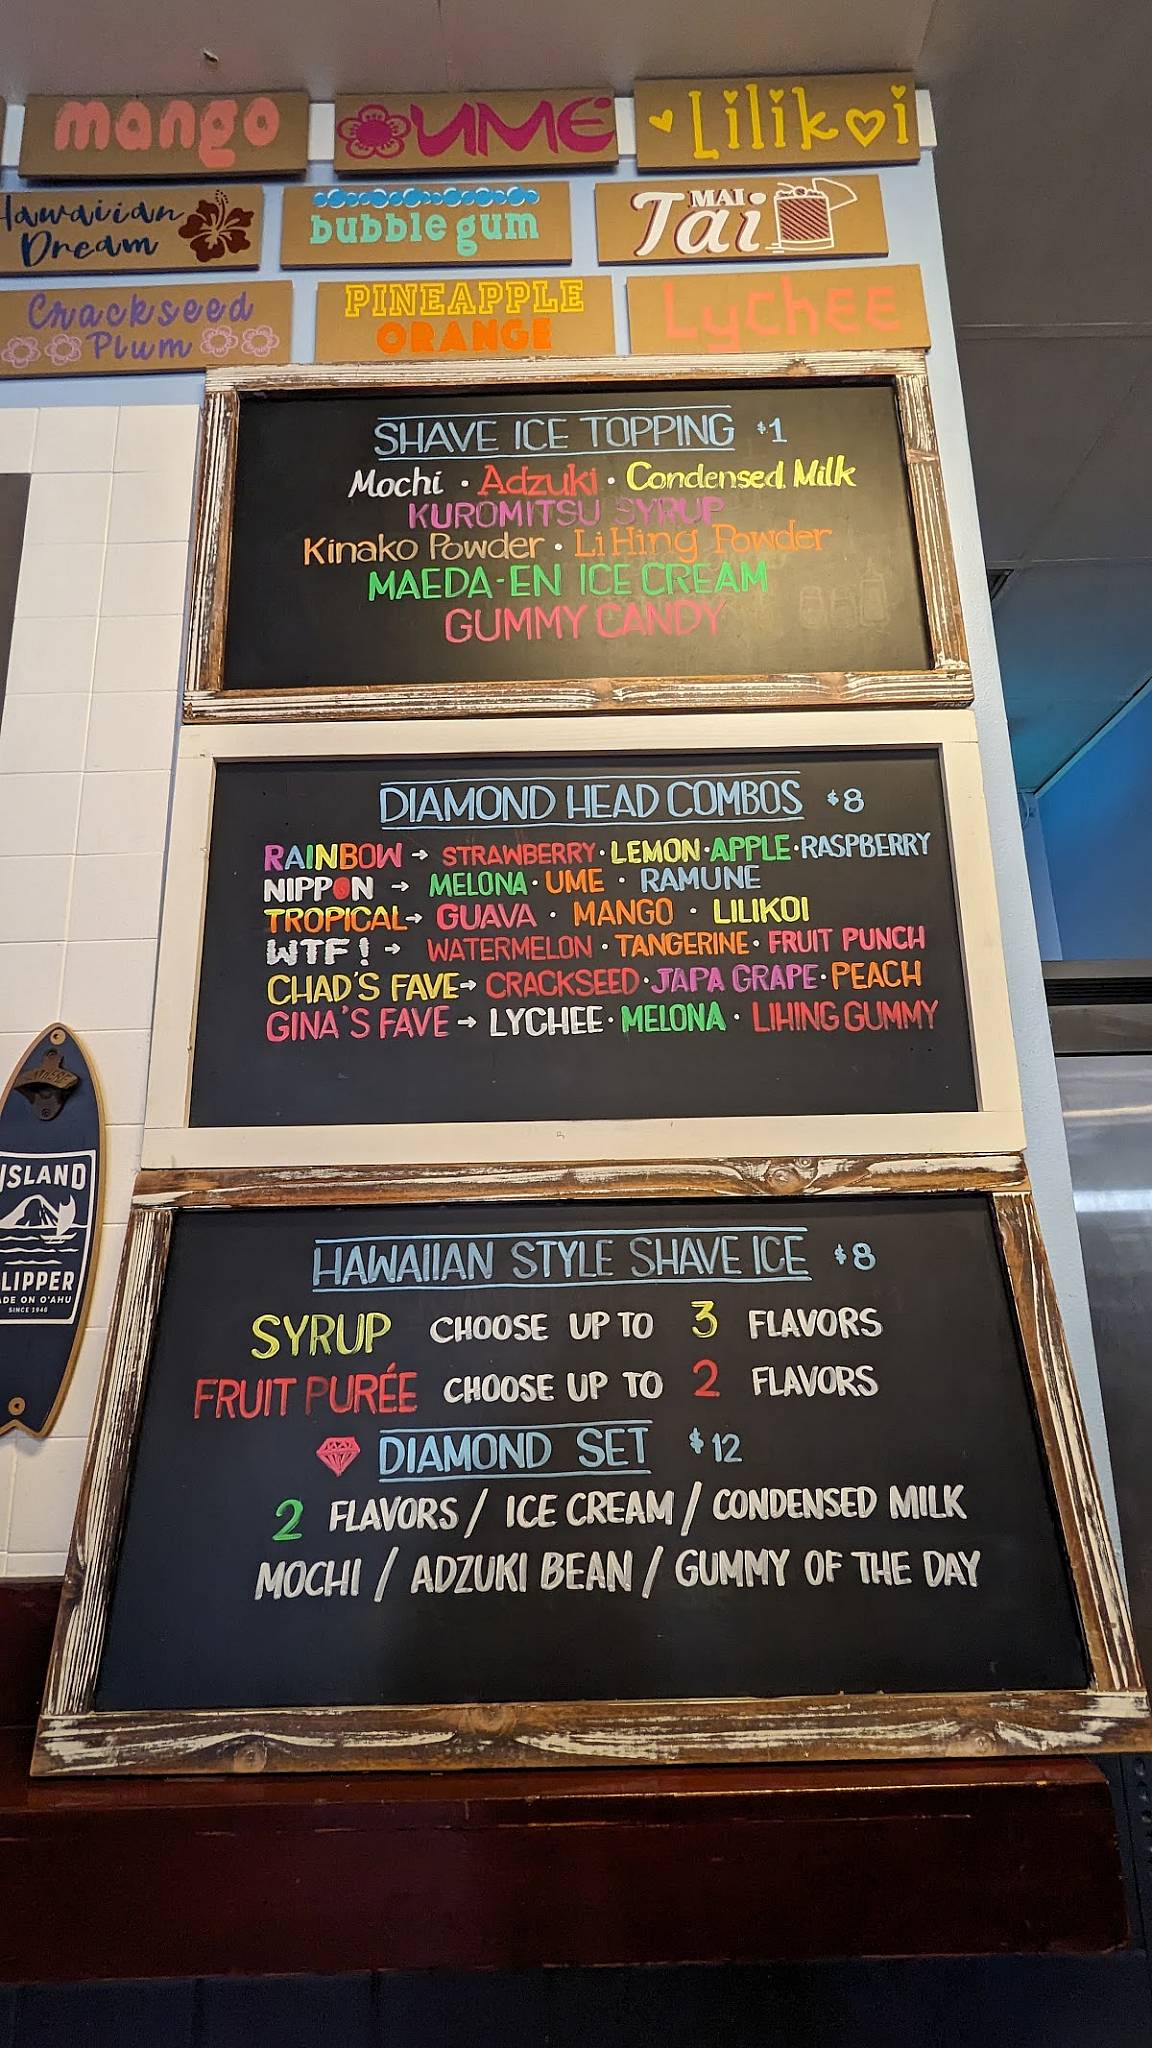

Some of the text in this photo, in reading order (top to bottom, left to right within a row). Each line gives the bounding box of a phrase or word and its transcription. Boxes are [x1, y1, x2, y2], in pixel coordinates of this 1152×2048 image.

[54, 97, 280, 169] mango
[690, 188, 745, 208] MAI
[310, 212, 540, 257] bubble gum
[631, 191, 767, 257] Tai
[21, 230, 159, 267] Dream
[28, 291, 253, 331] Crackseed
[344, 279, 584, 319] PINEAPPLE
[87, 330, 193, 361] Plum
[376, 317, 552, 354] ORANGE
[374, 413, 788, 456] SHAVE ICE TOPPING $1
[347, 455, 857, 498] Mochi Adzuki Condensed Milk
[408, 497, 727, 529] KUROMITSU SYRUP
[303, 533, 418, 566] Kinako
[430, 532, 546, 562] Powder
[711, 519, 833, 555] Powder
[368, 560, 768, 602] MAEDA-EN ICE CREAM
[444, 601, 727, 643] GUMMY CANDY
[379, 779, 866, 823] DIAMOND HEAD COMBOS $8
[264, 832, 931, 872] RAINBOW STRAWBERRY LEMON APPLE RASPBERRY
[263, 864, 762, 903] NIPPON MELONA UME RAMUNE
[263, 896, 810, 934] TROPICAL GUAVA MANGO LILIKOI
[427, 934, 593, 963] WATERMELON
[614, 930, 750, 958] TANGERINE
[767, 928, 834, 954] FRUIT
[842, 925, 926, 952] PUNCH
[267, 960, 923, 1006] CHAD'S FAVE CRACKSEED JAPA GRAPE PEACH
[265, 999, 939, 1043] GINA'S FAVE LYCHEE MELONA LIHING GUMMY
[0, 1163, 87, 1192] ISLAND
[312, 1235, 877, 1286] HAWAIIAN STYLE SHAVE ICE $8
[20, 1295, 36, 1304] ON
[250, 1300, 884, 1360] SYRUP CHOOSE UP TO 3 FLAVORS
[193, 1359, 879, 1420] FRUIT PURÉE CHOOSE UP TO 2 FLAVORS
[378, 1430, 553, 1476] DIAMOND
[576, 1426, 649, 1469] SET
[271, 1498, 305, 1543] 2
[328, 1495, 460, 1533] FLAVORS
[505, 1493, 558, 1529] ICE
[565, 1489, 674, 1526] CREAM
[712, 1485, 877, 1521] CONDENSED
[888, 1484, 968, 1521] MILK
[254, 1557, 362, 1602] MOCHI
[410, 1551, 528, 1594] ADZUKI
[540, 1549, 634, 1593] BEAN
[674, 1548, 791, 1587] GUMMY
[803, 1549, 843, 1586] OF
[850, 1549, 913, 1586] THE
[923, 1549, 981, 1588] DAY
